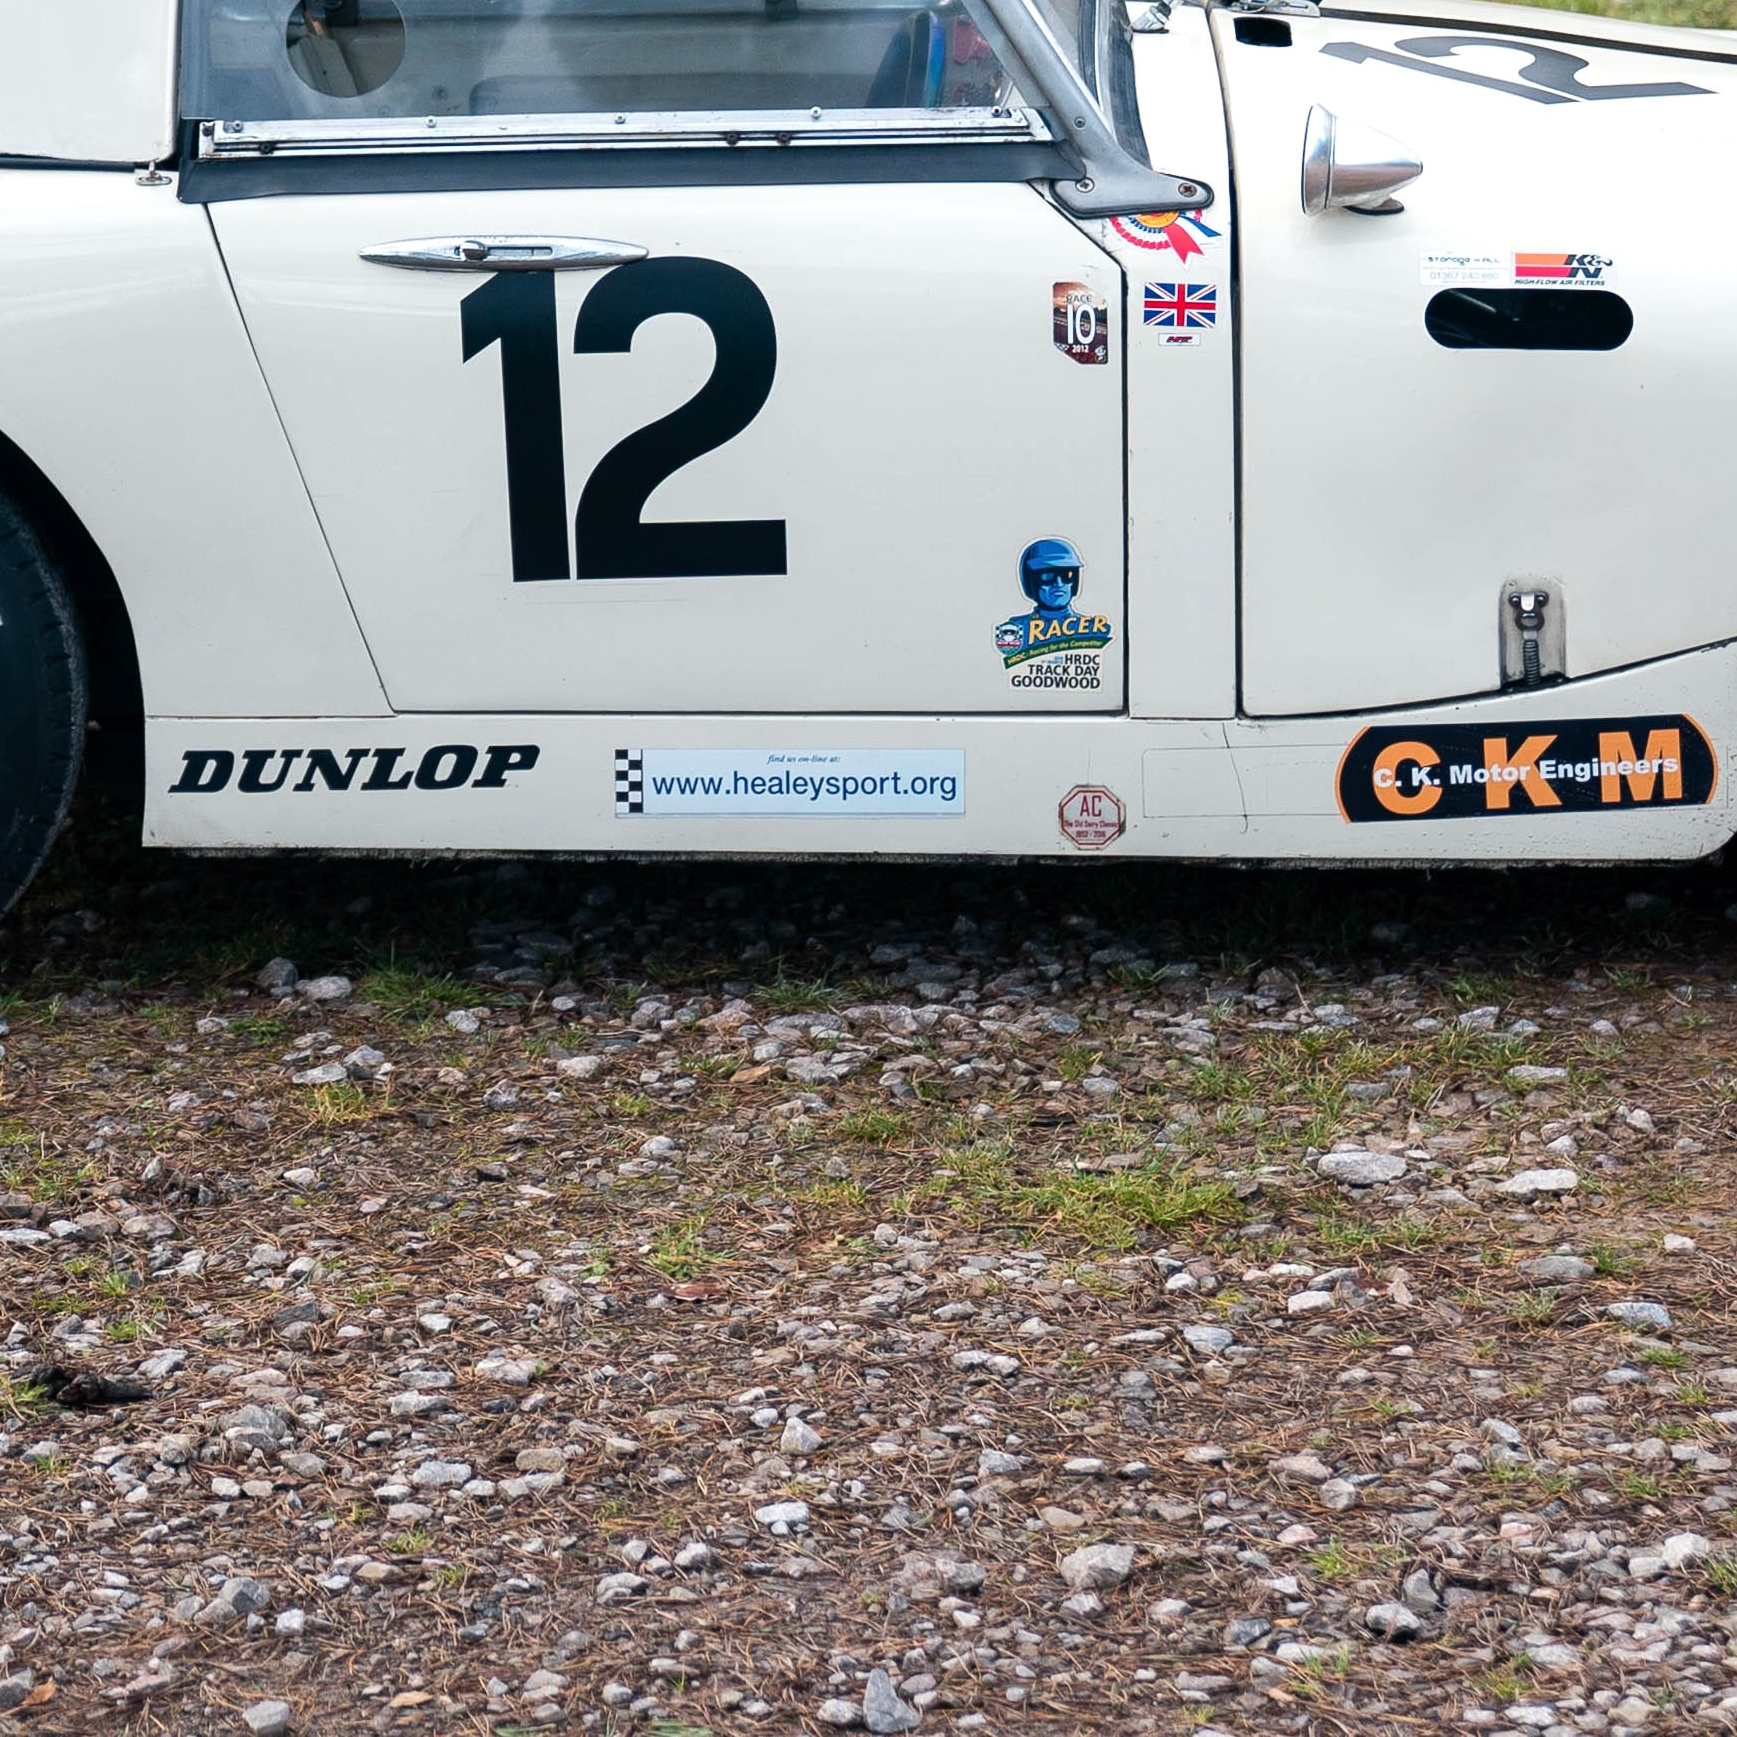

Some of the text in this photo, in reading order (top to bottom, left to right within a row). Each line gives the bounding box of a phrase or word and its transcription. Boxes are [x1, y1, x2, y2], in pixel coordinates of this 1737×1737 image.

[1318, 35, 1719, 104] 12
[1065, 293, 1093, 304] RACE
[1067, 303, 1096, 345] 10
[460, 256, 787, 582] 12
[1028, 614, 1109, 645] RACER
[1028, 664, 1100, 677] TRACK DAY
[1064, 654, 1100, 665] HRDC
[1011, 675, 1100, 689] GOODWOOD
[168, 744, 540, 793] DUNLOP
[1450, 762, 1531, 786] Motor
[1540, 756, 1679, 783] Engineers
[652, 770, 958, 802] www.healeysport.org
[1079, 795, 1102, 817] AC
